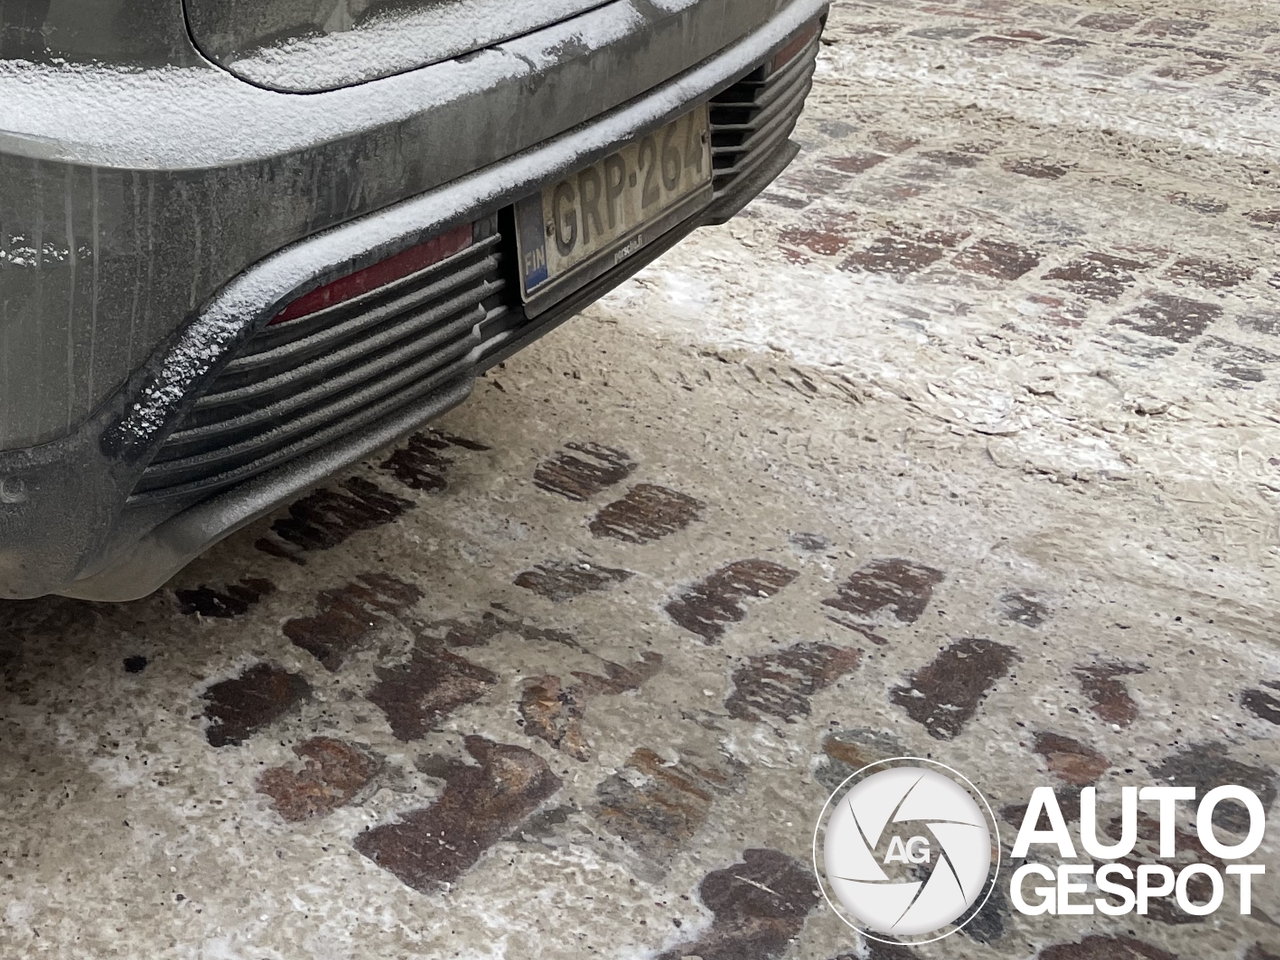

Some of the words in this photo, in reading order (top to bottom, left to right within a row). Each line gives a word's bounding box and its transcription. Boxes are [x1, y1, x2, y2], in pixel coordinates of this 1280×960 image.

[552, 110, 704, 258] GRP-264
[524, 245, 547, 276] FIN
[613, 234, 643, 265] porsche.fi
